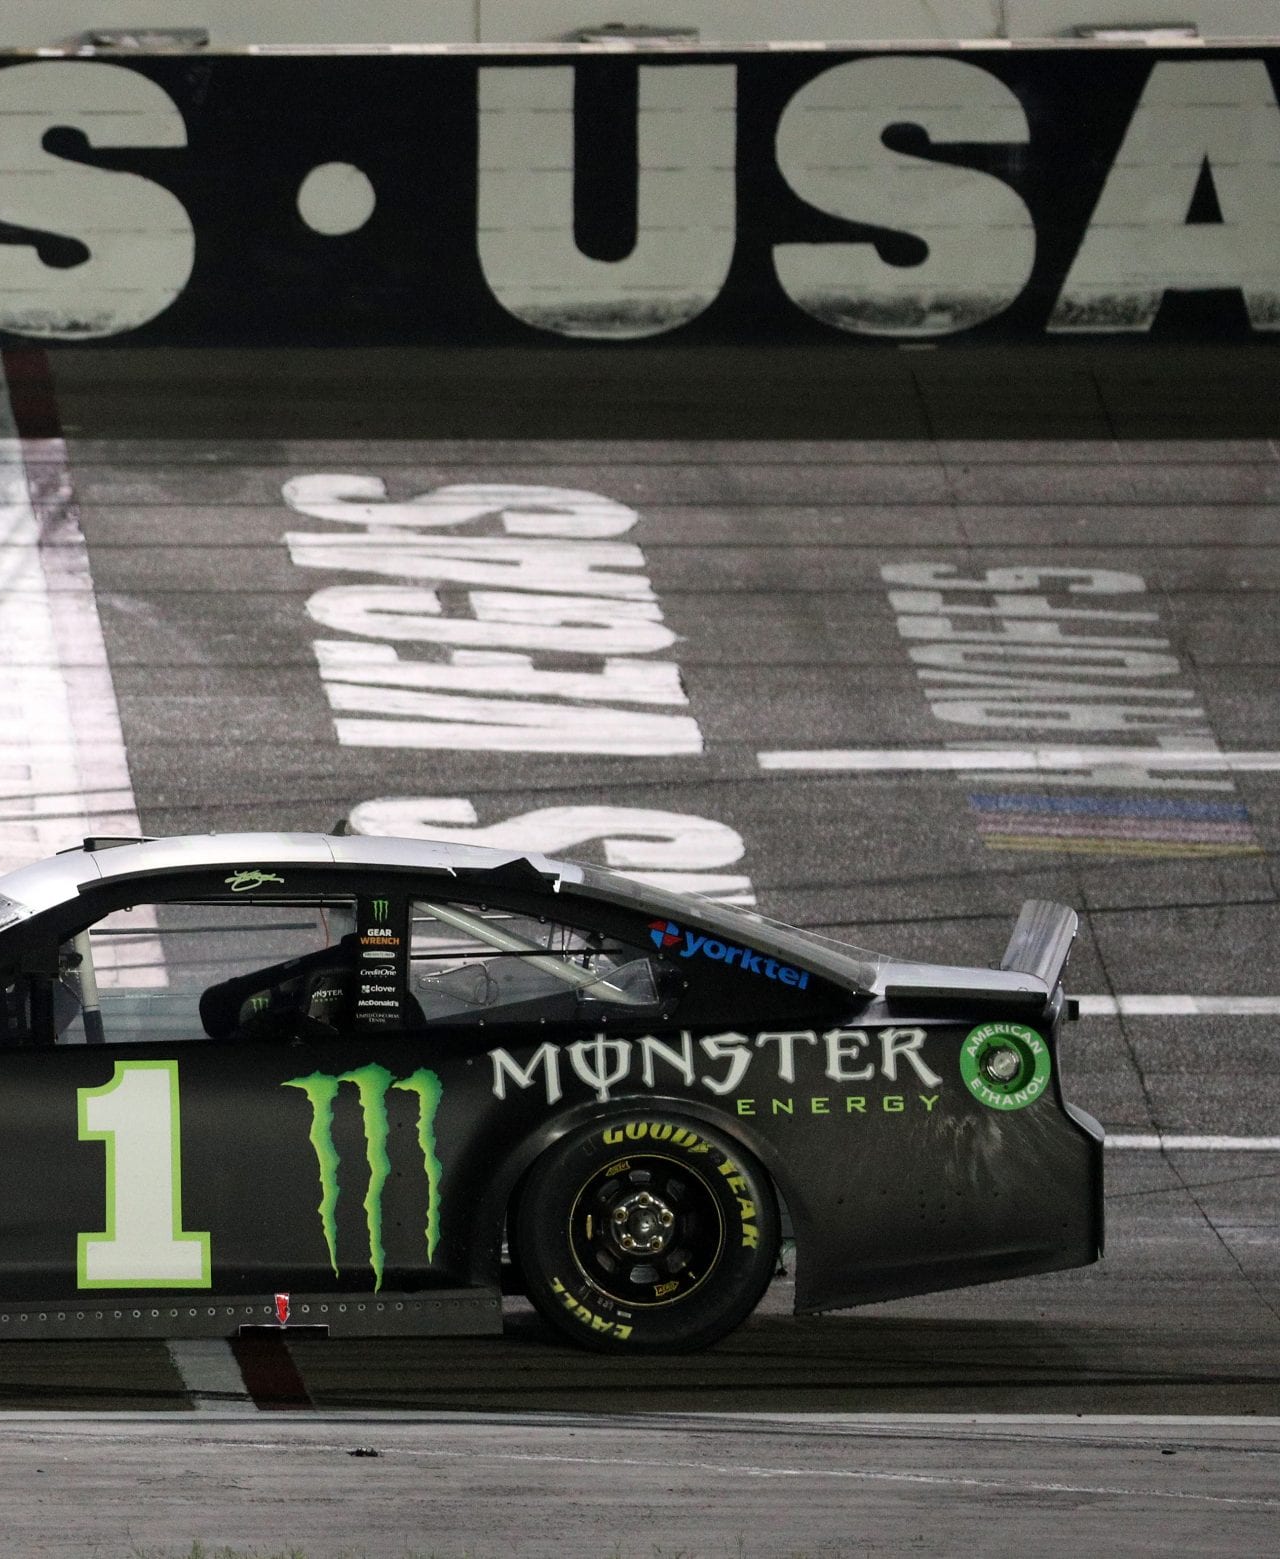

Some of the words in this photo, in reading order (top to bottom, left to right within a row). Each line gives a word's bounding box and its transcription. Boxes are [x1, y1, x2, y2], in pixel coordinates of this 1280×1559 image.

[476, 55, 1280, 340] USA
[282, 474, 704, 757] VEGAS
[360, 937, 400, 945] WRENCH
[367, 928, 392, 937] GEAR
[679, 929, 810, 991] yorktel
[370, 984, 396, 993] clover
[966, 1023, 1044, 1058] AMERICAN
[487, 1026, 944, 1104] MONSTER
[737, 1094, 941, 1116] ENERGY
[970, 1075, 1045, 1105] ETHANOL
[77, 1060, 212, 1289] 1
